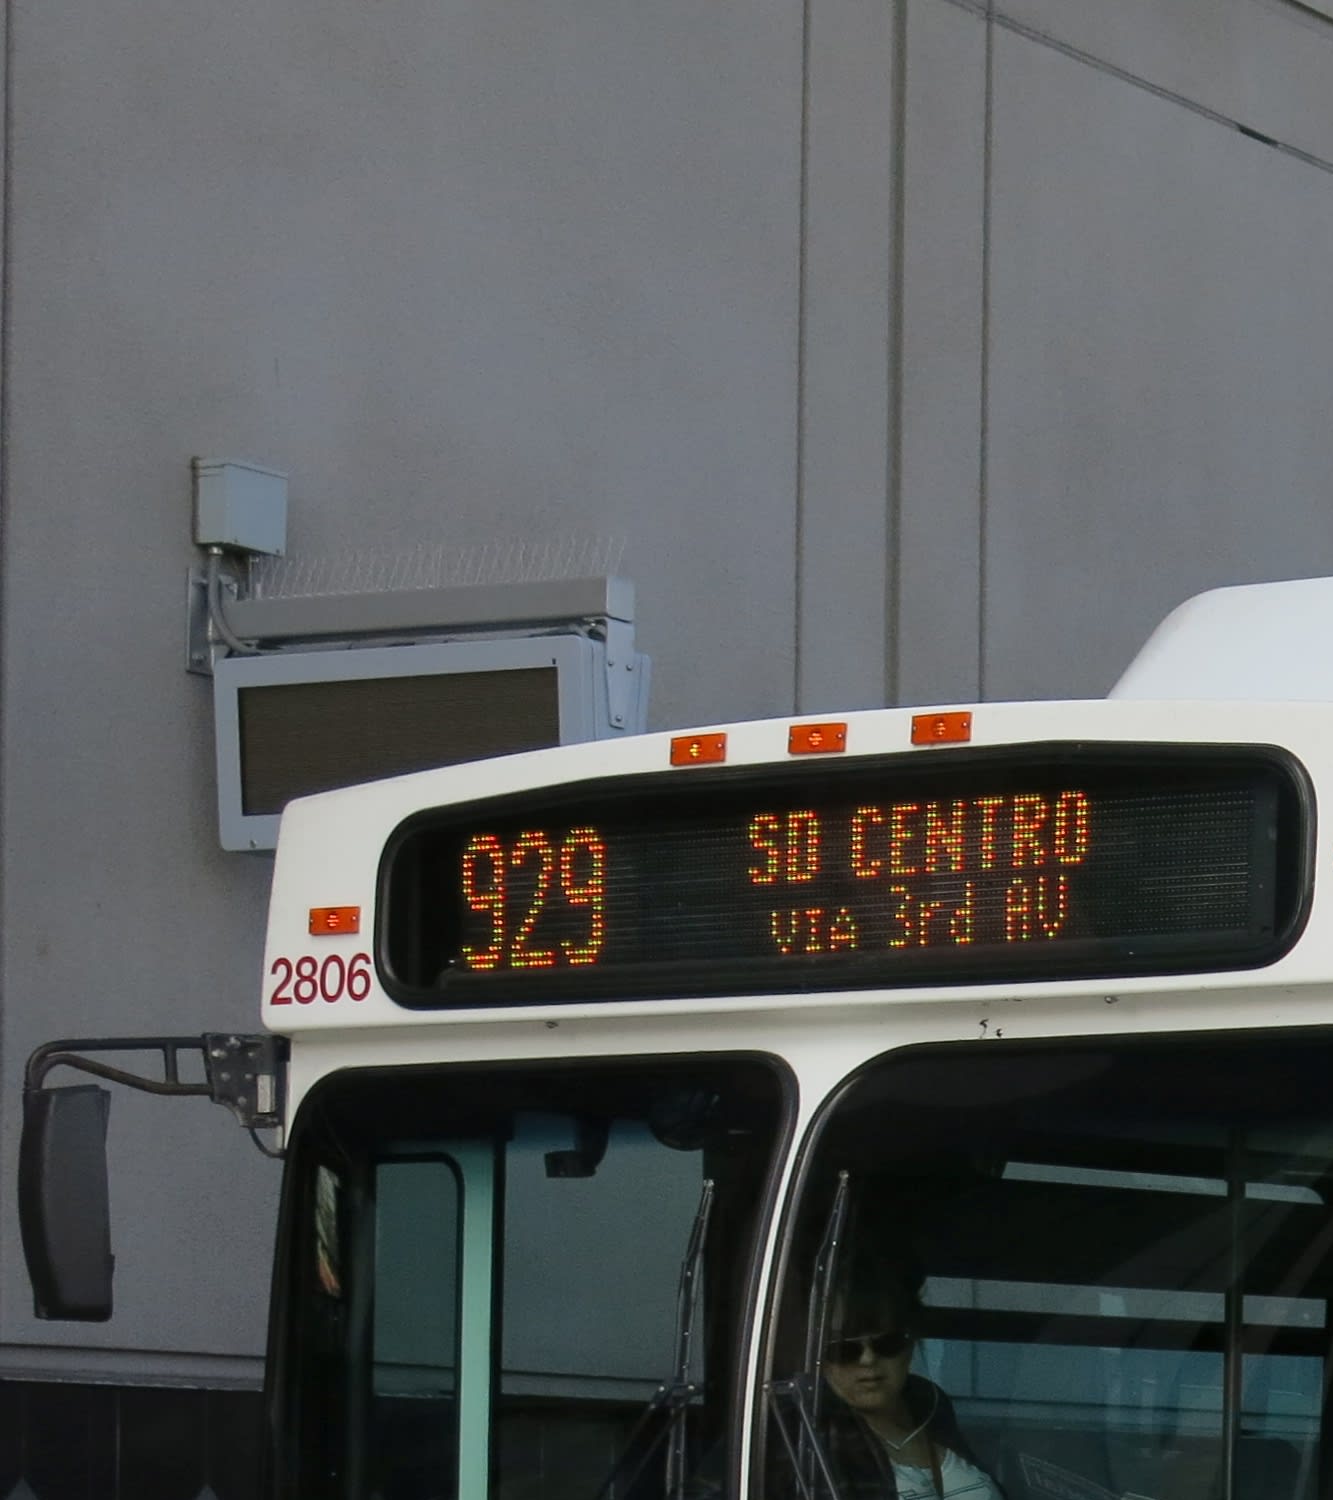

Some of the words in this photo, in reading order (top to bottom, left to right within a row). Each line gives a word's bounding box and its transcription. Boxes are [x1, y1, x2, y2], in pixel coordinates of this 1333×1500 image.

[749, 808, 822, 883] SD
[851, 790, 1089, 879] CENTRO
[461, 827, 606, 970] 929
[770, 907, 858, 954] VIA
[889, 881, 975, 949] 3rd
[1004, 874, 1067, 941] AV
[270, 952, 372, 1006] 2806
